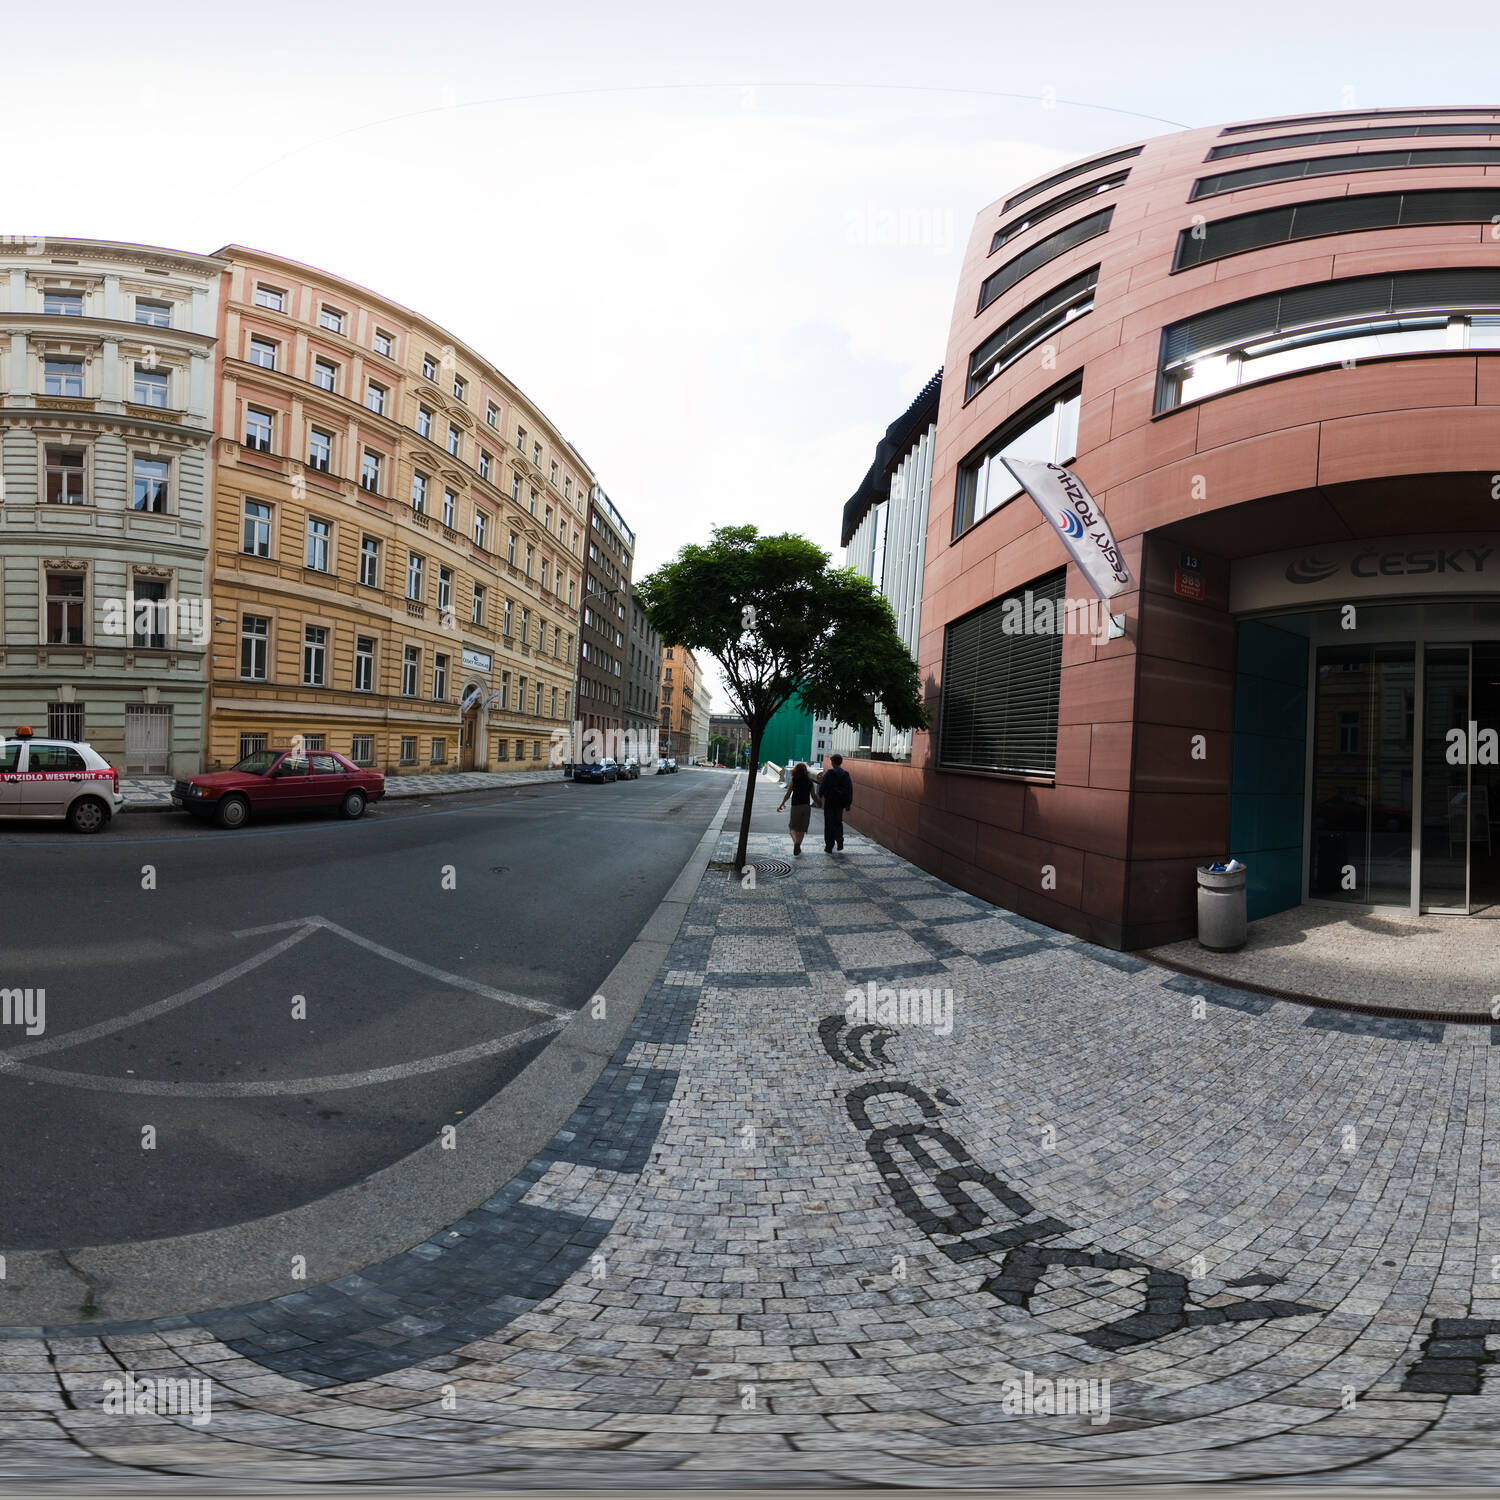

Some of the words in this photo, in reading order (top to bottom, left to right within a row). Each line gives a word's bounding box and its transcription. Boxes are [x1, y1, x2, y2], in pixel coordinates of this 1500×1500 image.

[1047, 462, 1097, 528] ROZHLA
[1089, 532, 1128, 584] ČESKÝ
[1350, 544, 1493, 578] ČESKÝ
[45, 773, 96, 781] WESTPOINT
[844, 1080, 1329, 1350] ČESKÝ
